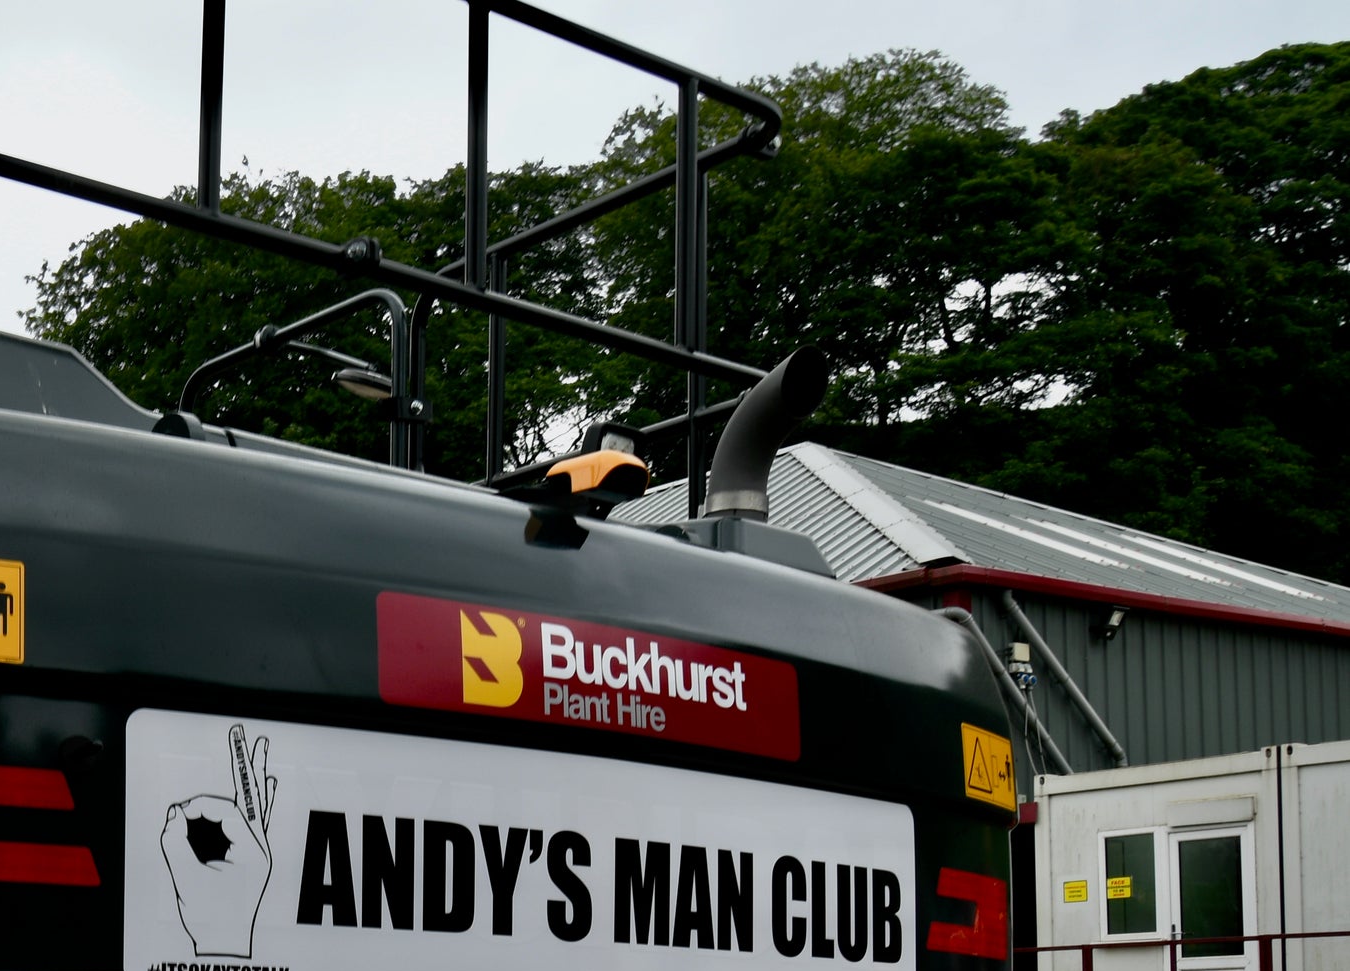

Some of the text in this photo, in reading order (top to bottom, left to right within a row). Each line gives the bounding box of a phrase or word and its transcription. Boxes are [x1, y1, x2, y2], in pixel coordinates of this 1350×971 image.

[541, 622, 748, 712] Buckhurst
[543, 680, 666, 733] Plant Hire
[296, 810, 902, 964] ANDY'S MAN CLUB
